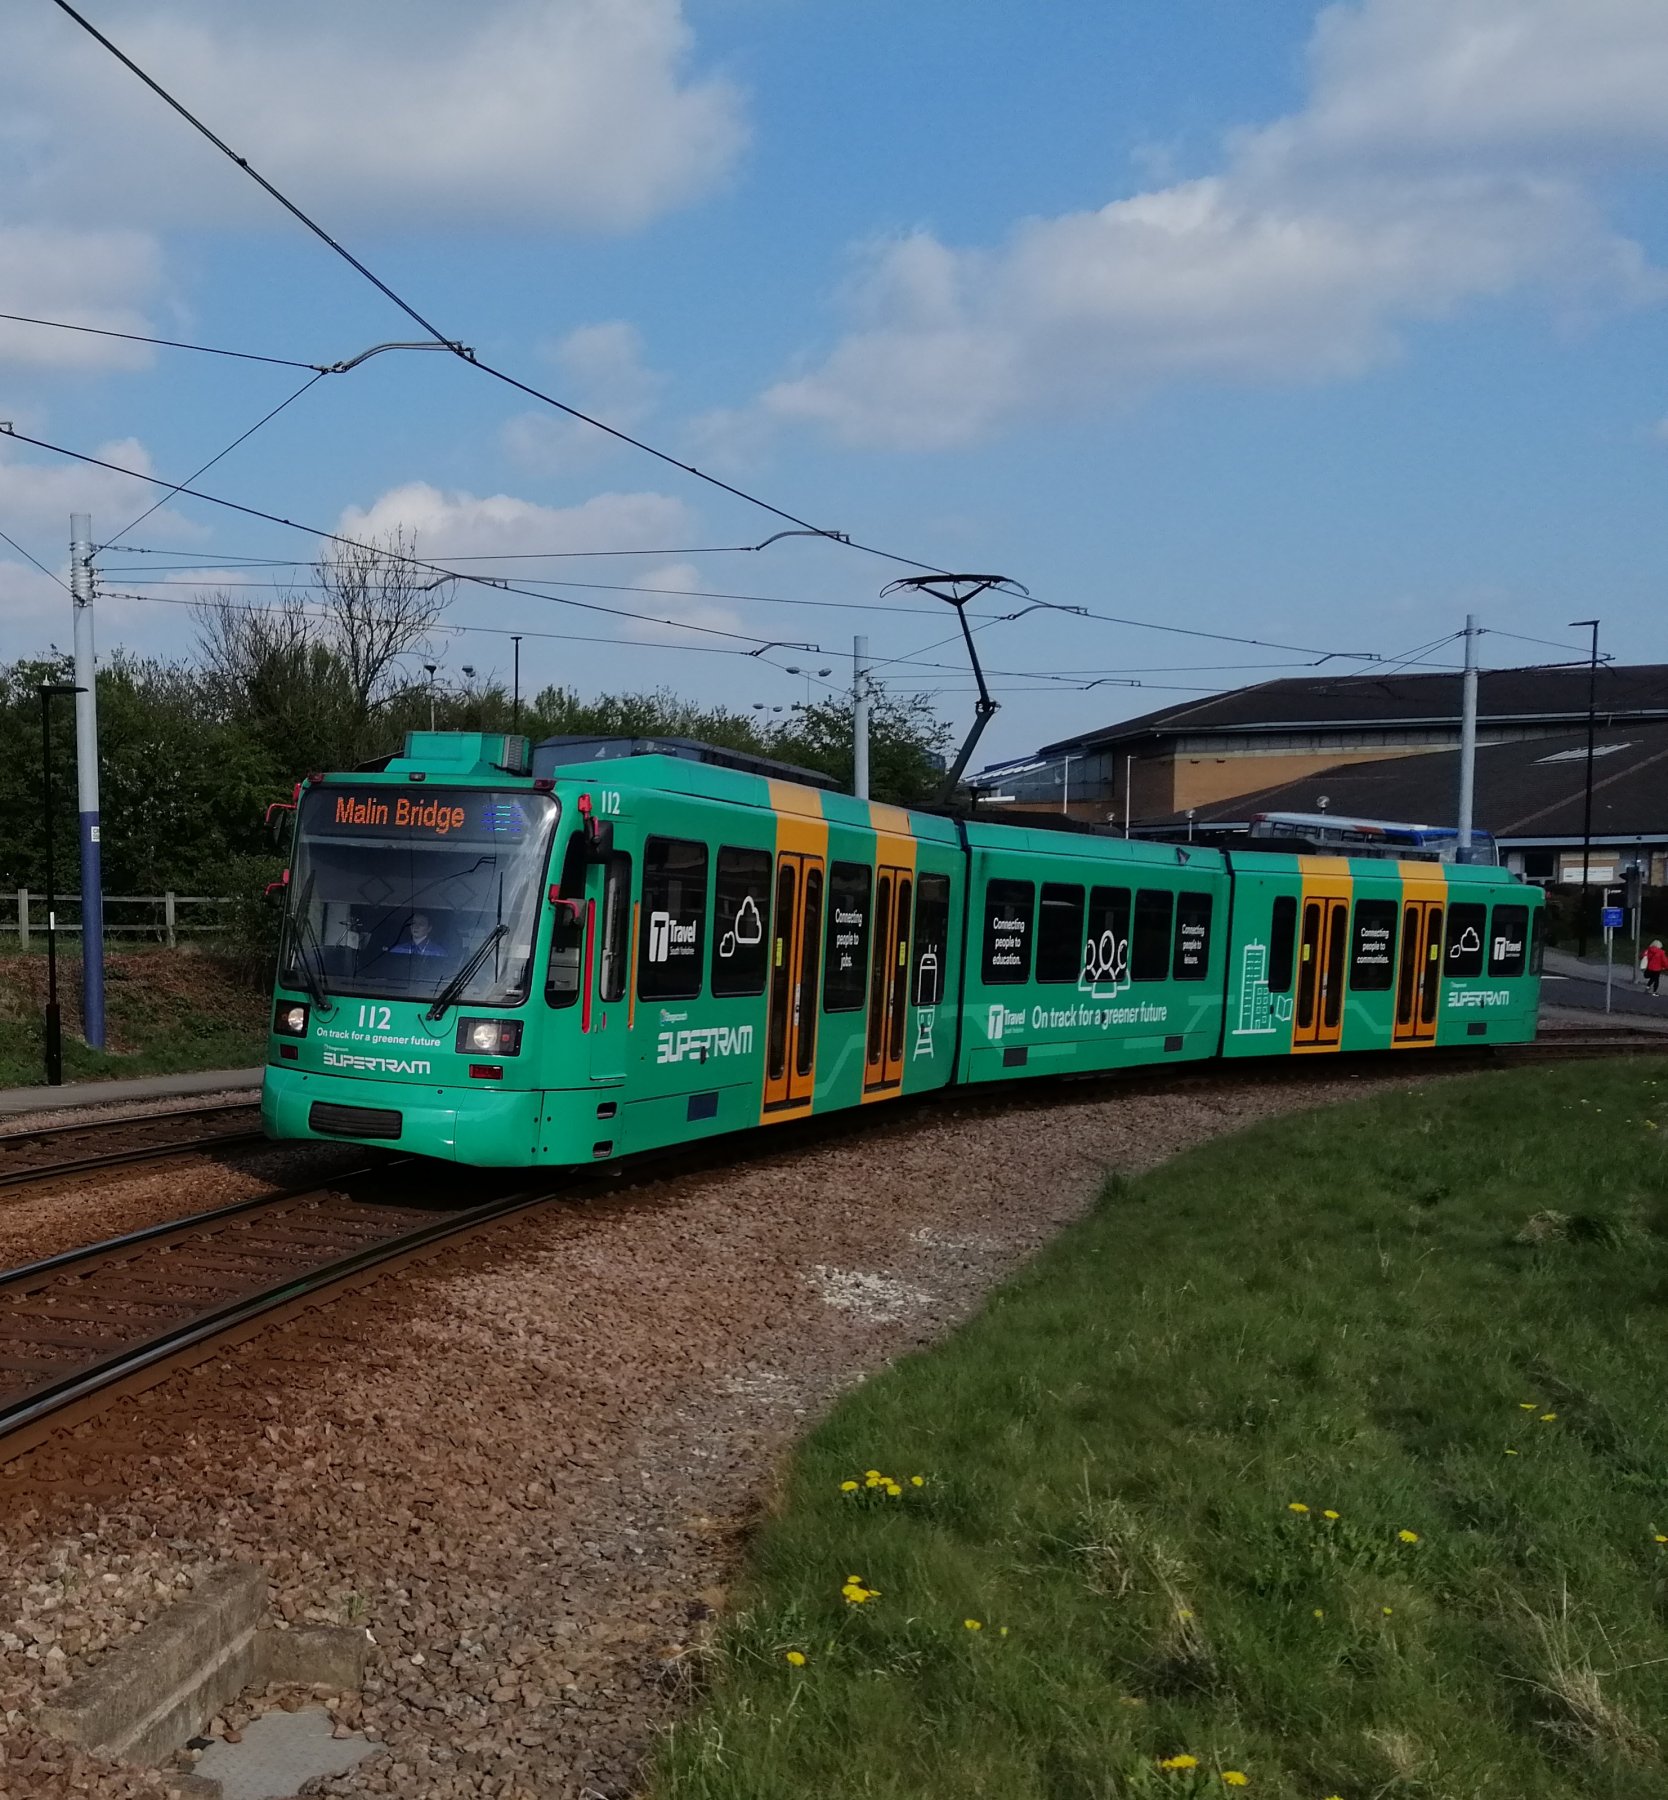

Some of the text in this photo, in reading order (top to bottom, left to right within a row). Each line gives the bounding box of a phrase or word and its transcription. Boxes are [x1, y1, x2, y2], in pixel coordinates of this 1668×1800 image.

[601, 790, 621, 815] 112
[335, 796, 465, 834] Malin Bridge
[669, 919, 697, 943] Travel
[993, 917, 1025, 933] Connecting
[995, 934, 1014, 950] people
[992, 952, 1022, 965] education.
[358, 1004, 392, 1030] 112
[1003, 1008, 1026, 1026] Travel
[1032, 1000, 1168, 1031] On track for a greener future
[316, 1027, 441, 1047] On track for a greener future
[656, 1024, 753, 1064] SUPERTRAM
[323, 1051, 432, 1075] SUPERTRAM
